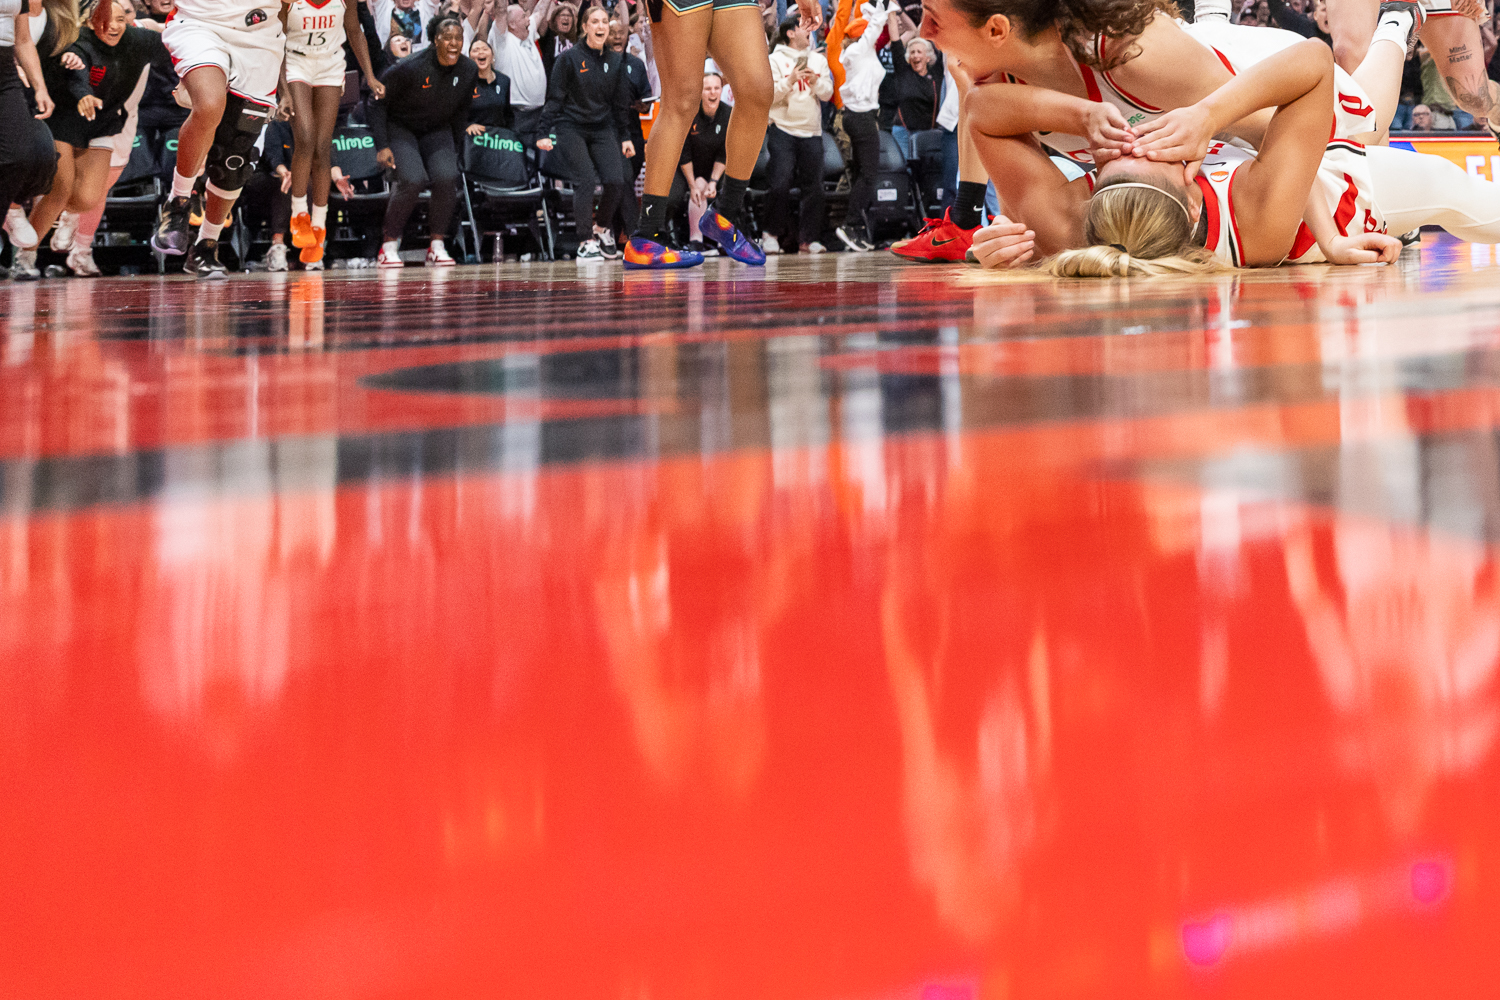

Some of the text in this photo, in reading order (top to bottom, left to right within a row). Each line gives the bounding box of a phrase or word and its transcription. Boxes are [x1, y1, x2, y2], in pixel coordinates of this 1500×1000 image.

[302, 14, 337, 30] FIRE
[306, 31, 327, 46] 13
[473, 133, 524, 153] chime
